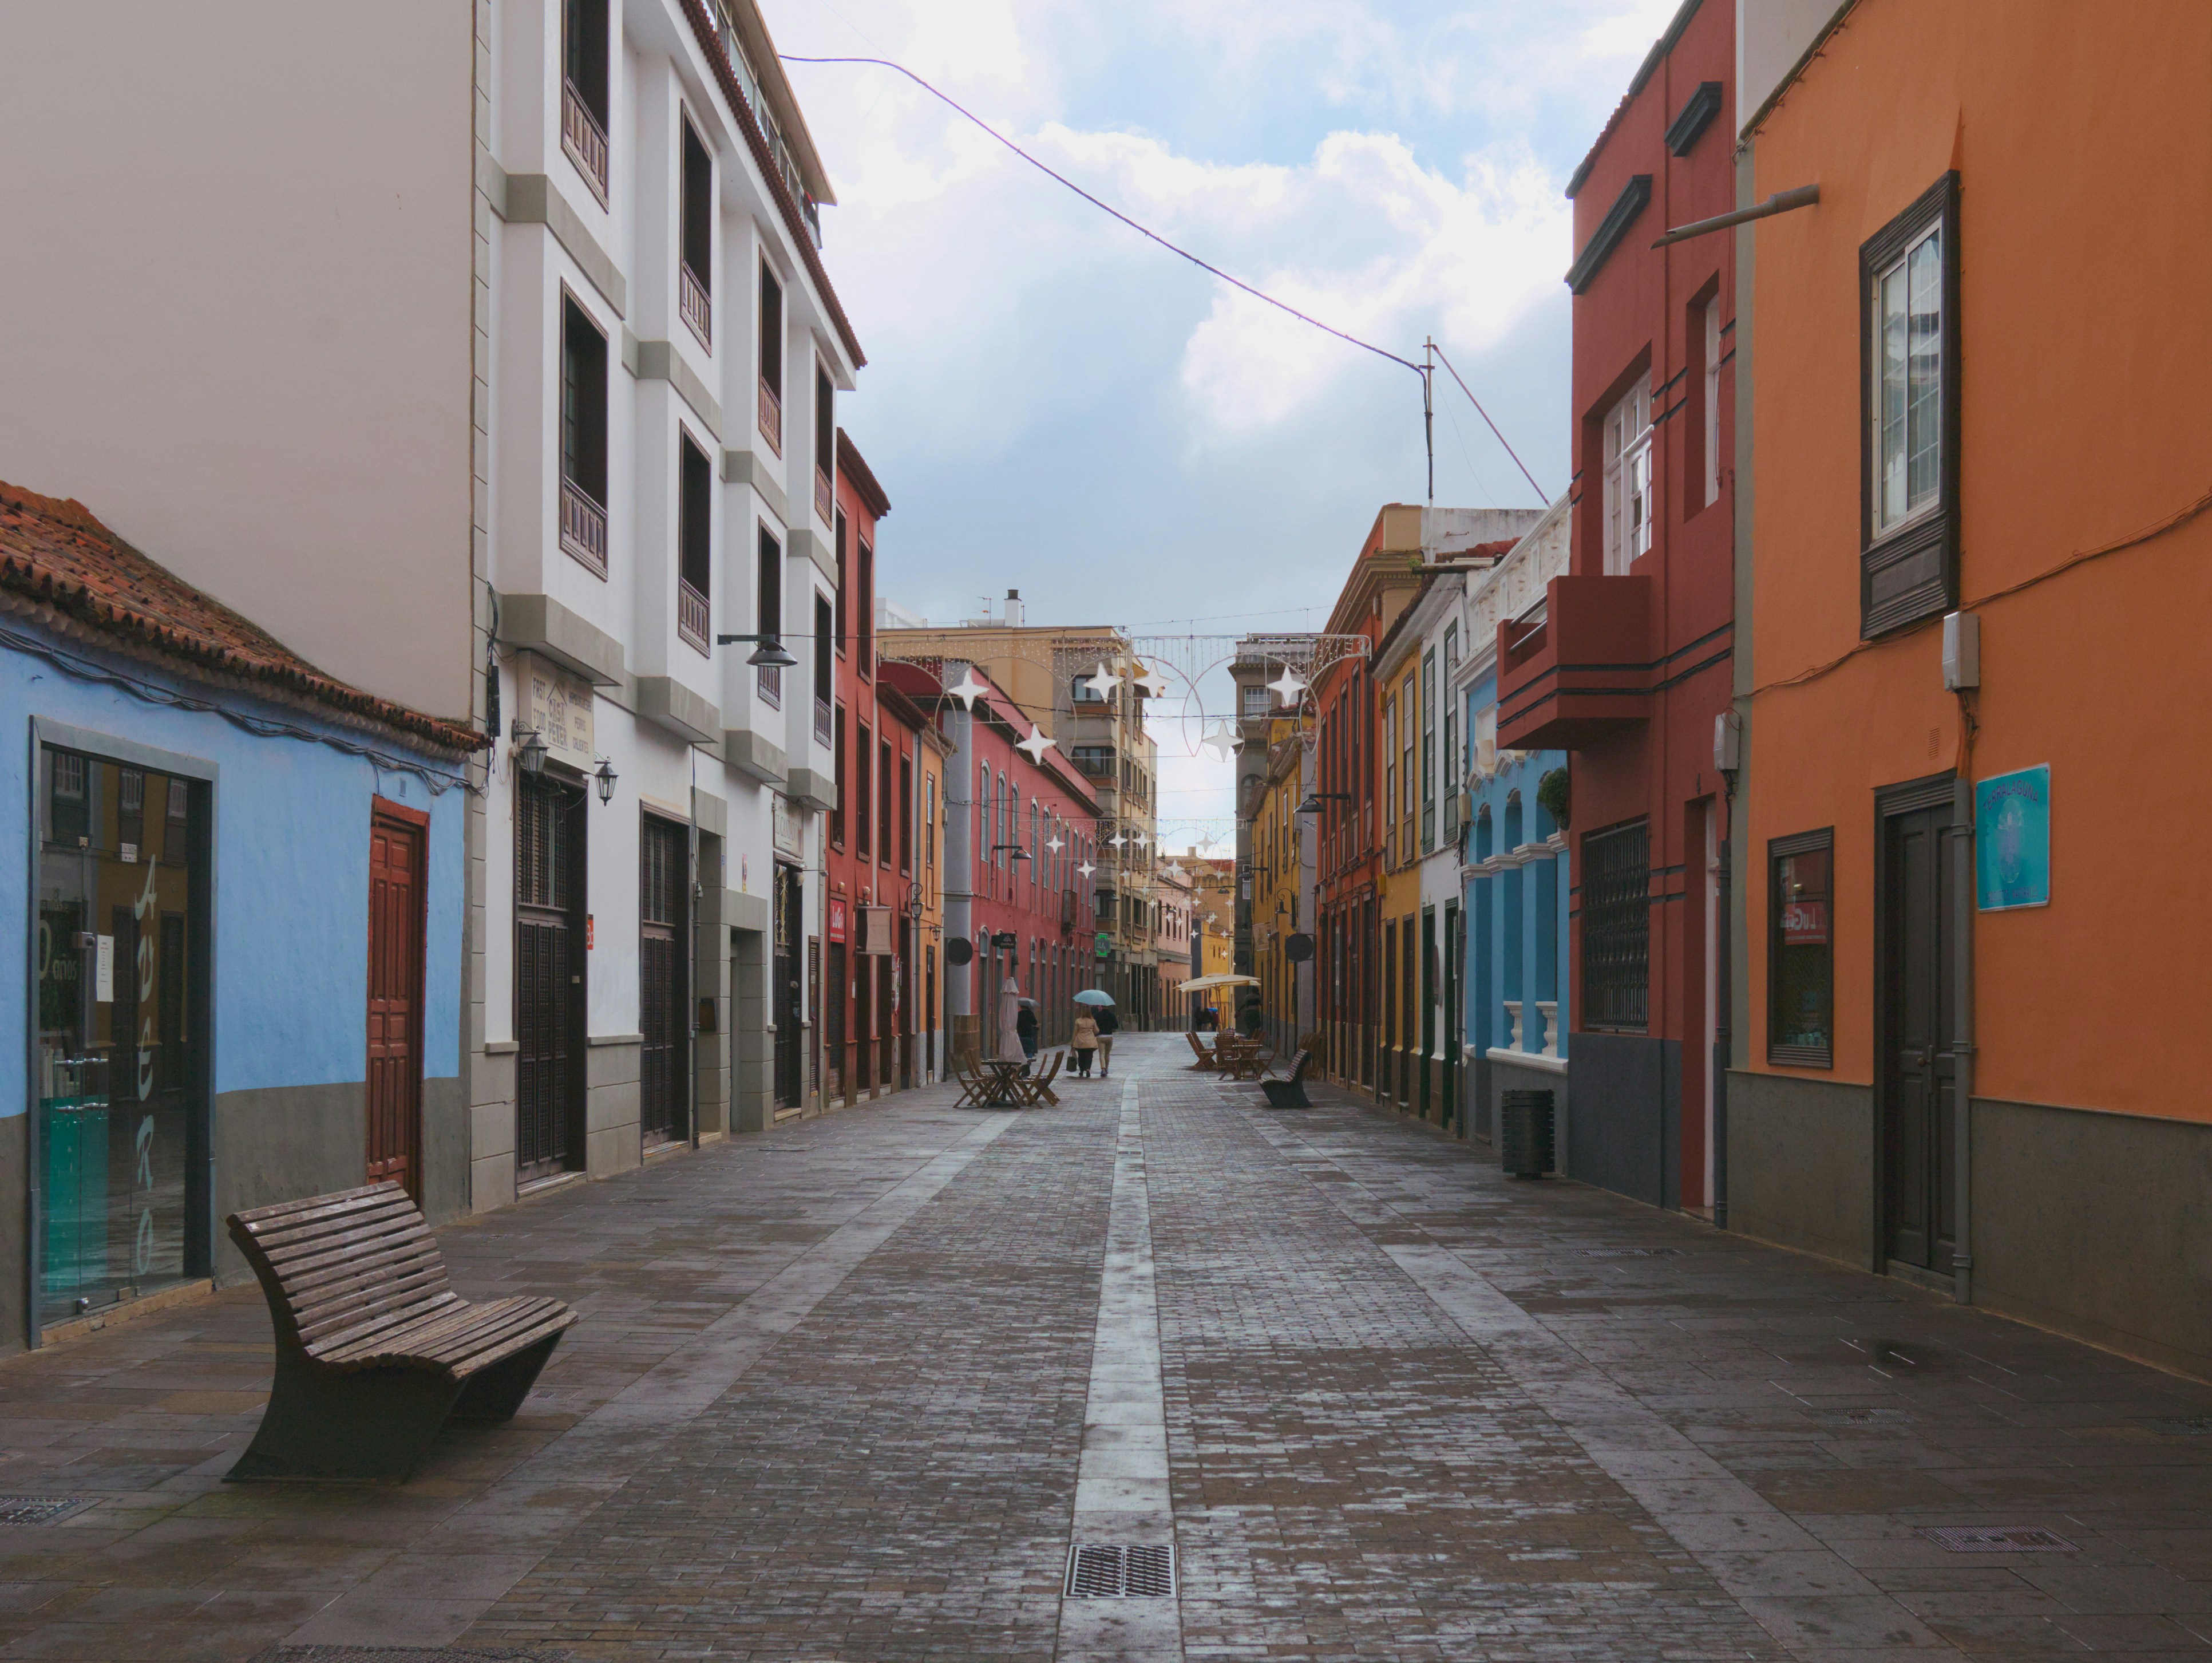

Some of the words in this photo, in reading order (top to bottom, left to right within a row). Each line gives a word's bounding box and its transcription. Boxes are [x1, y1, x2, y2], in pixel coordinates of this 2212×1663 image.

[533, 677, 545, 701] FAST
[533, 708, 546, 732] FOOD
[549, 698, 565, 726] CASA
[548, 721, 567, 747] PETER
[1983, 779, 2039, 815] TERRALAGUNA
